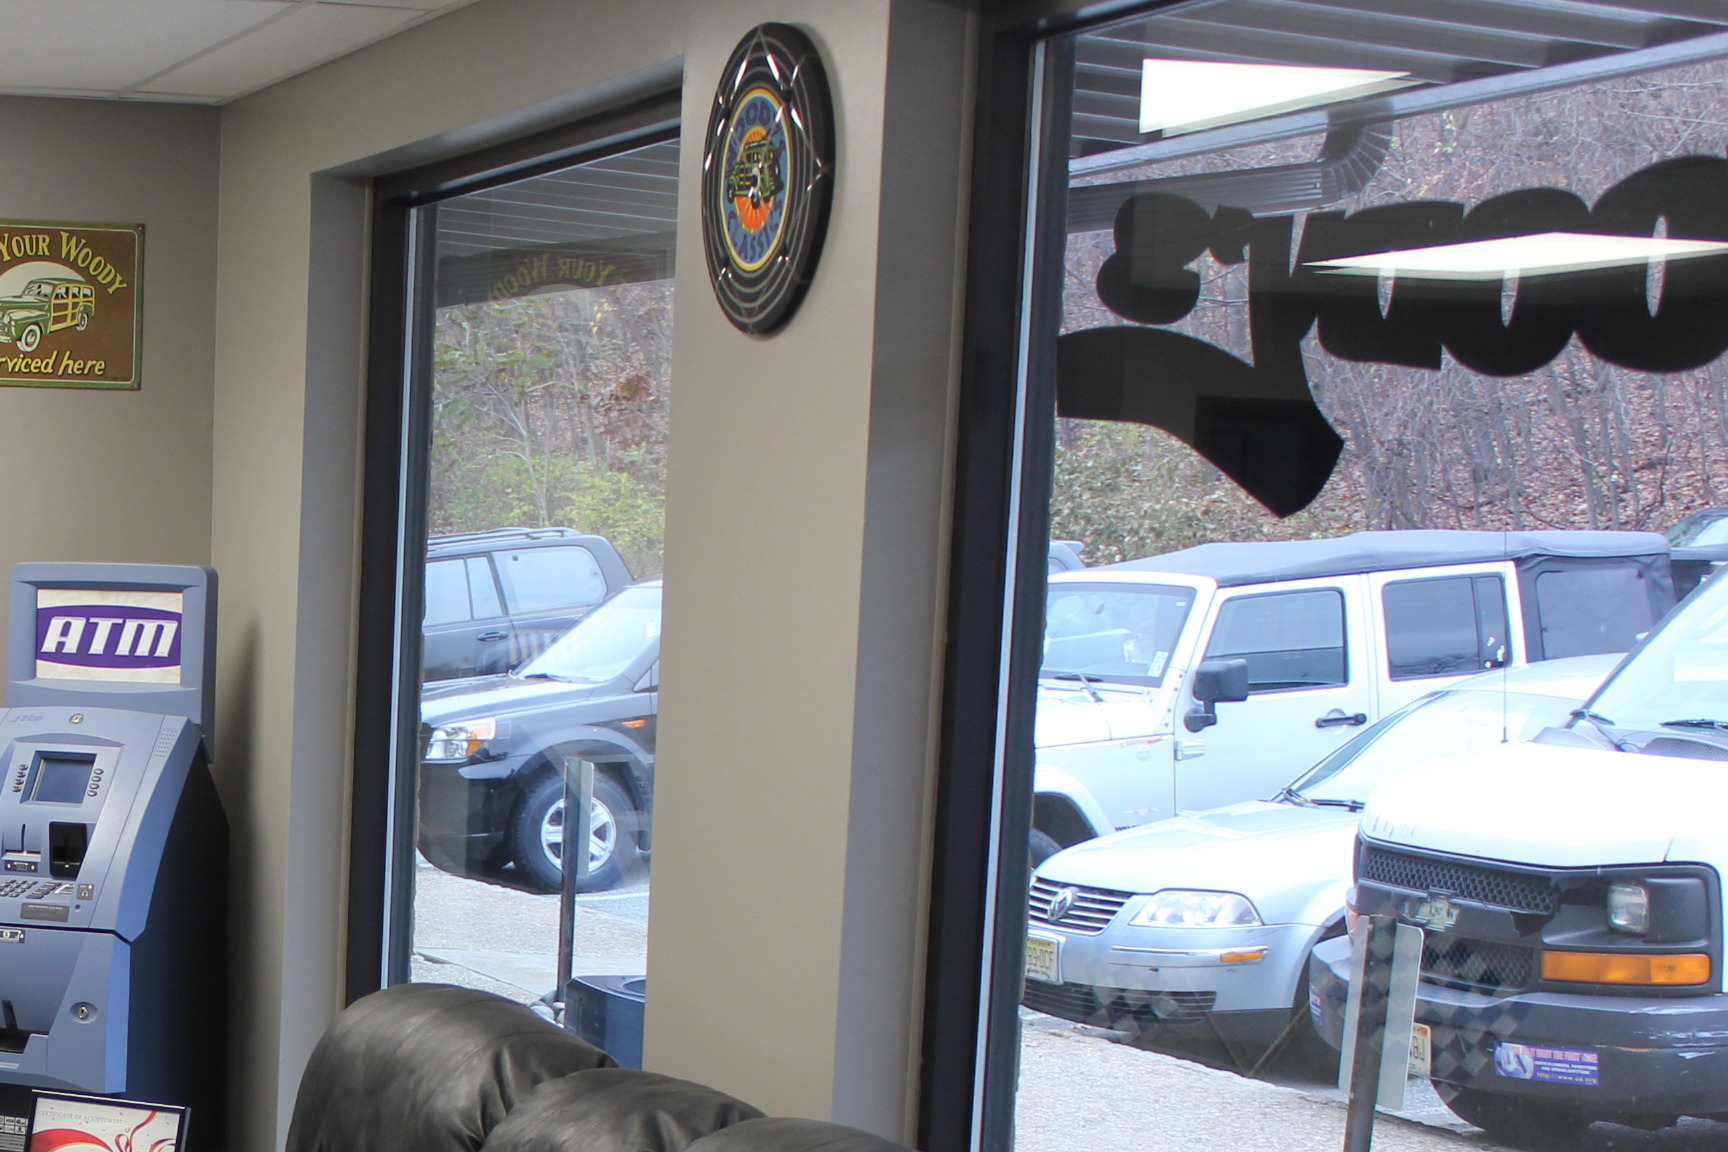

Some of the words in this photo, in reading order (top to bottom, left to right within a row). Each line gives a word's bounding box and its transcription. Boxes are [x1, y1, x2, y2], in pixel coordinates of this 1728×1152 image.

[59, 231, 128, 295] WOODY
[58, 351, 106, 376] here
[40, 615, 179, 658] ATM
[38, 1110, 73, 1119] CERTIFICATE
[83, 1115, 124, 1125] ACHIEVEMENT
